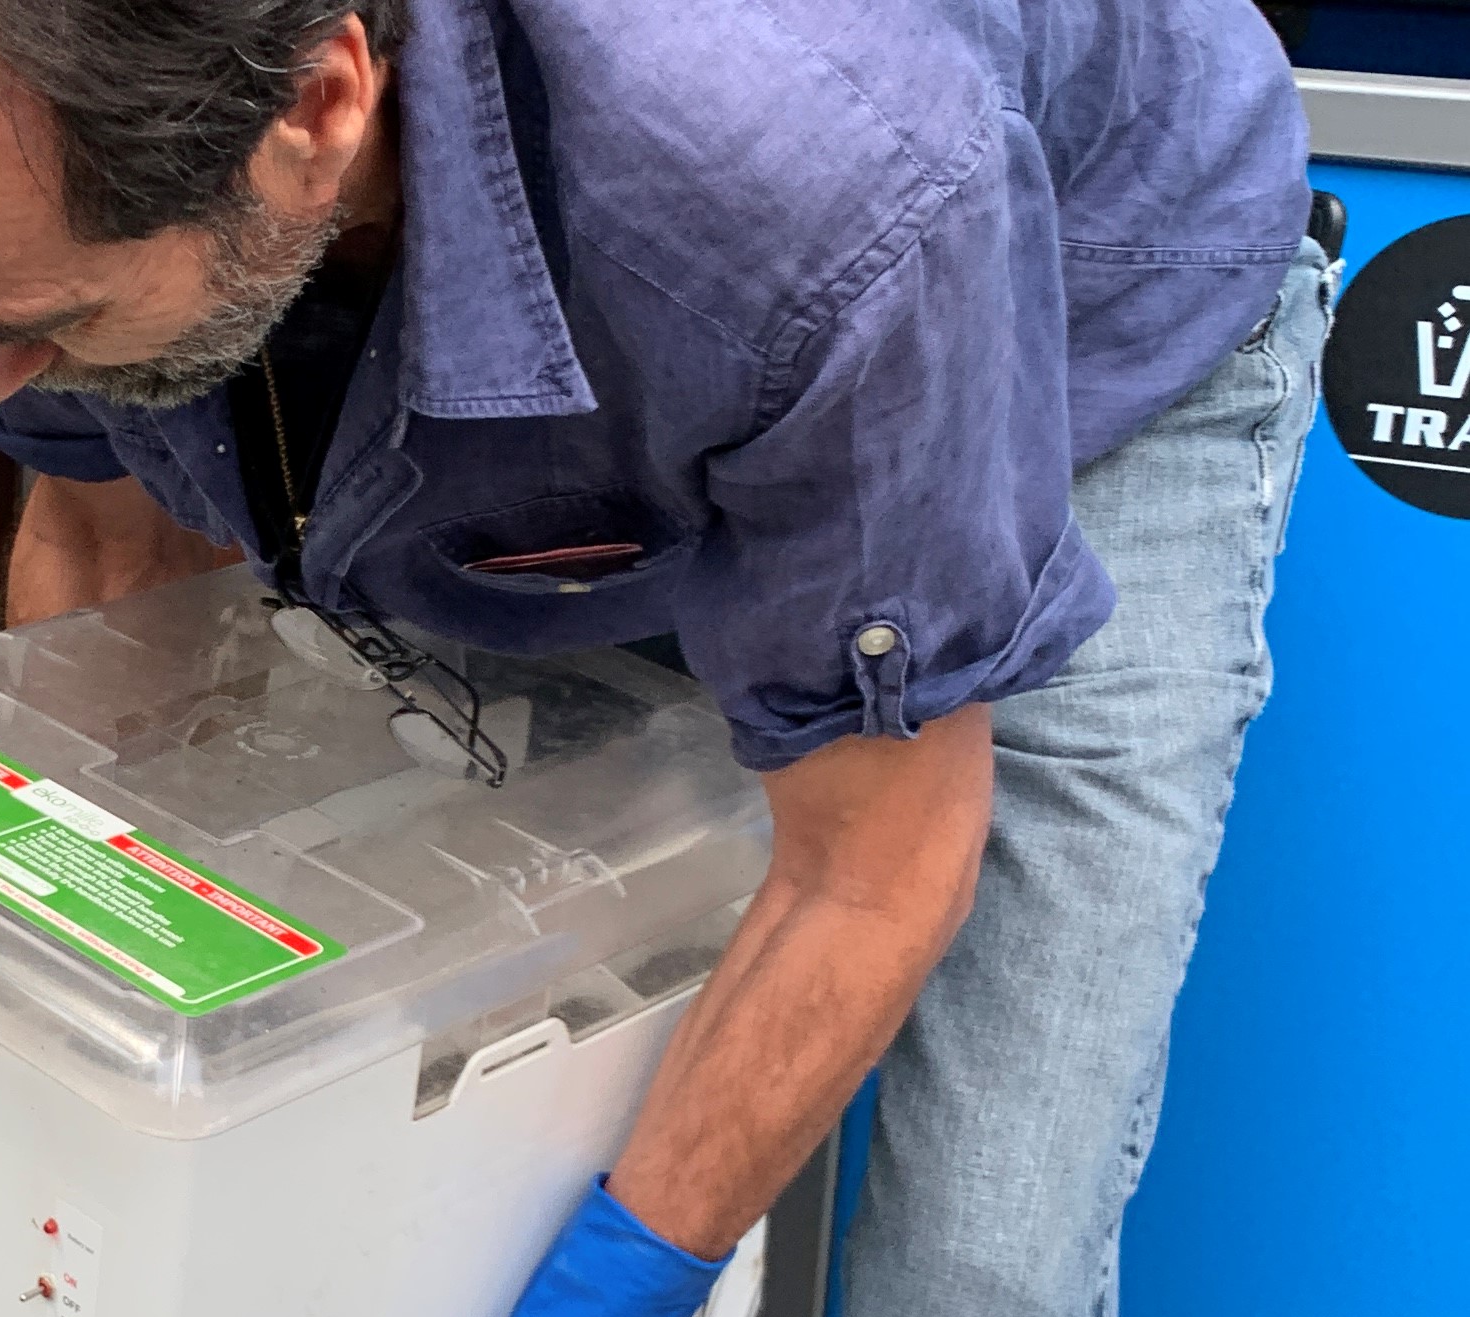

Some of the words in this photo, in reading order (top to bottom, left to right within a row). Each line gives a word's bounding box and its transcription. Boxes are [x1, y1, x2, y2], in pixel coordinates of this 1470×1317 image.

[126, 845, 199, 887] ATTENTION
[207, 891, 287, 936] IMPORTANT
[63, 1273, 78, 1289] ON
[62, 1295, 82, 1313] OFF
